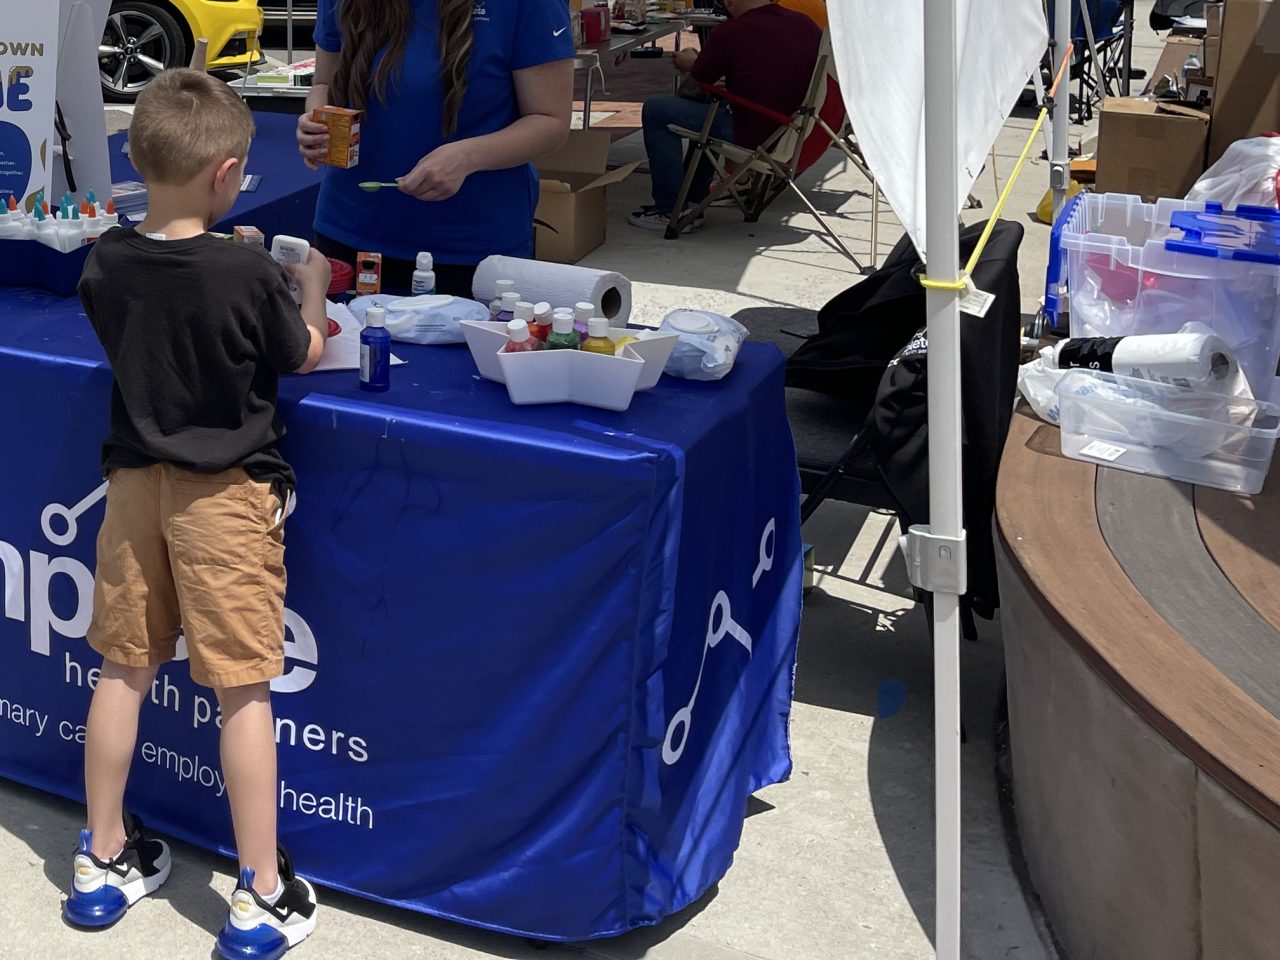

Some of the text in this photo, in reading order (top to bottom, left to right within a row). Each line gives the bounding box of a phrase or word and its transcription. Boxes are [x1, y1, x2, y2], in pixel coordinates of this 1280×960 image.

[65, 651, 180, 712] heth
[59, 720, 87, 744] ca
[280, 780, 373, 829] health
